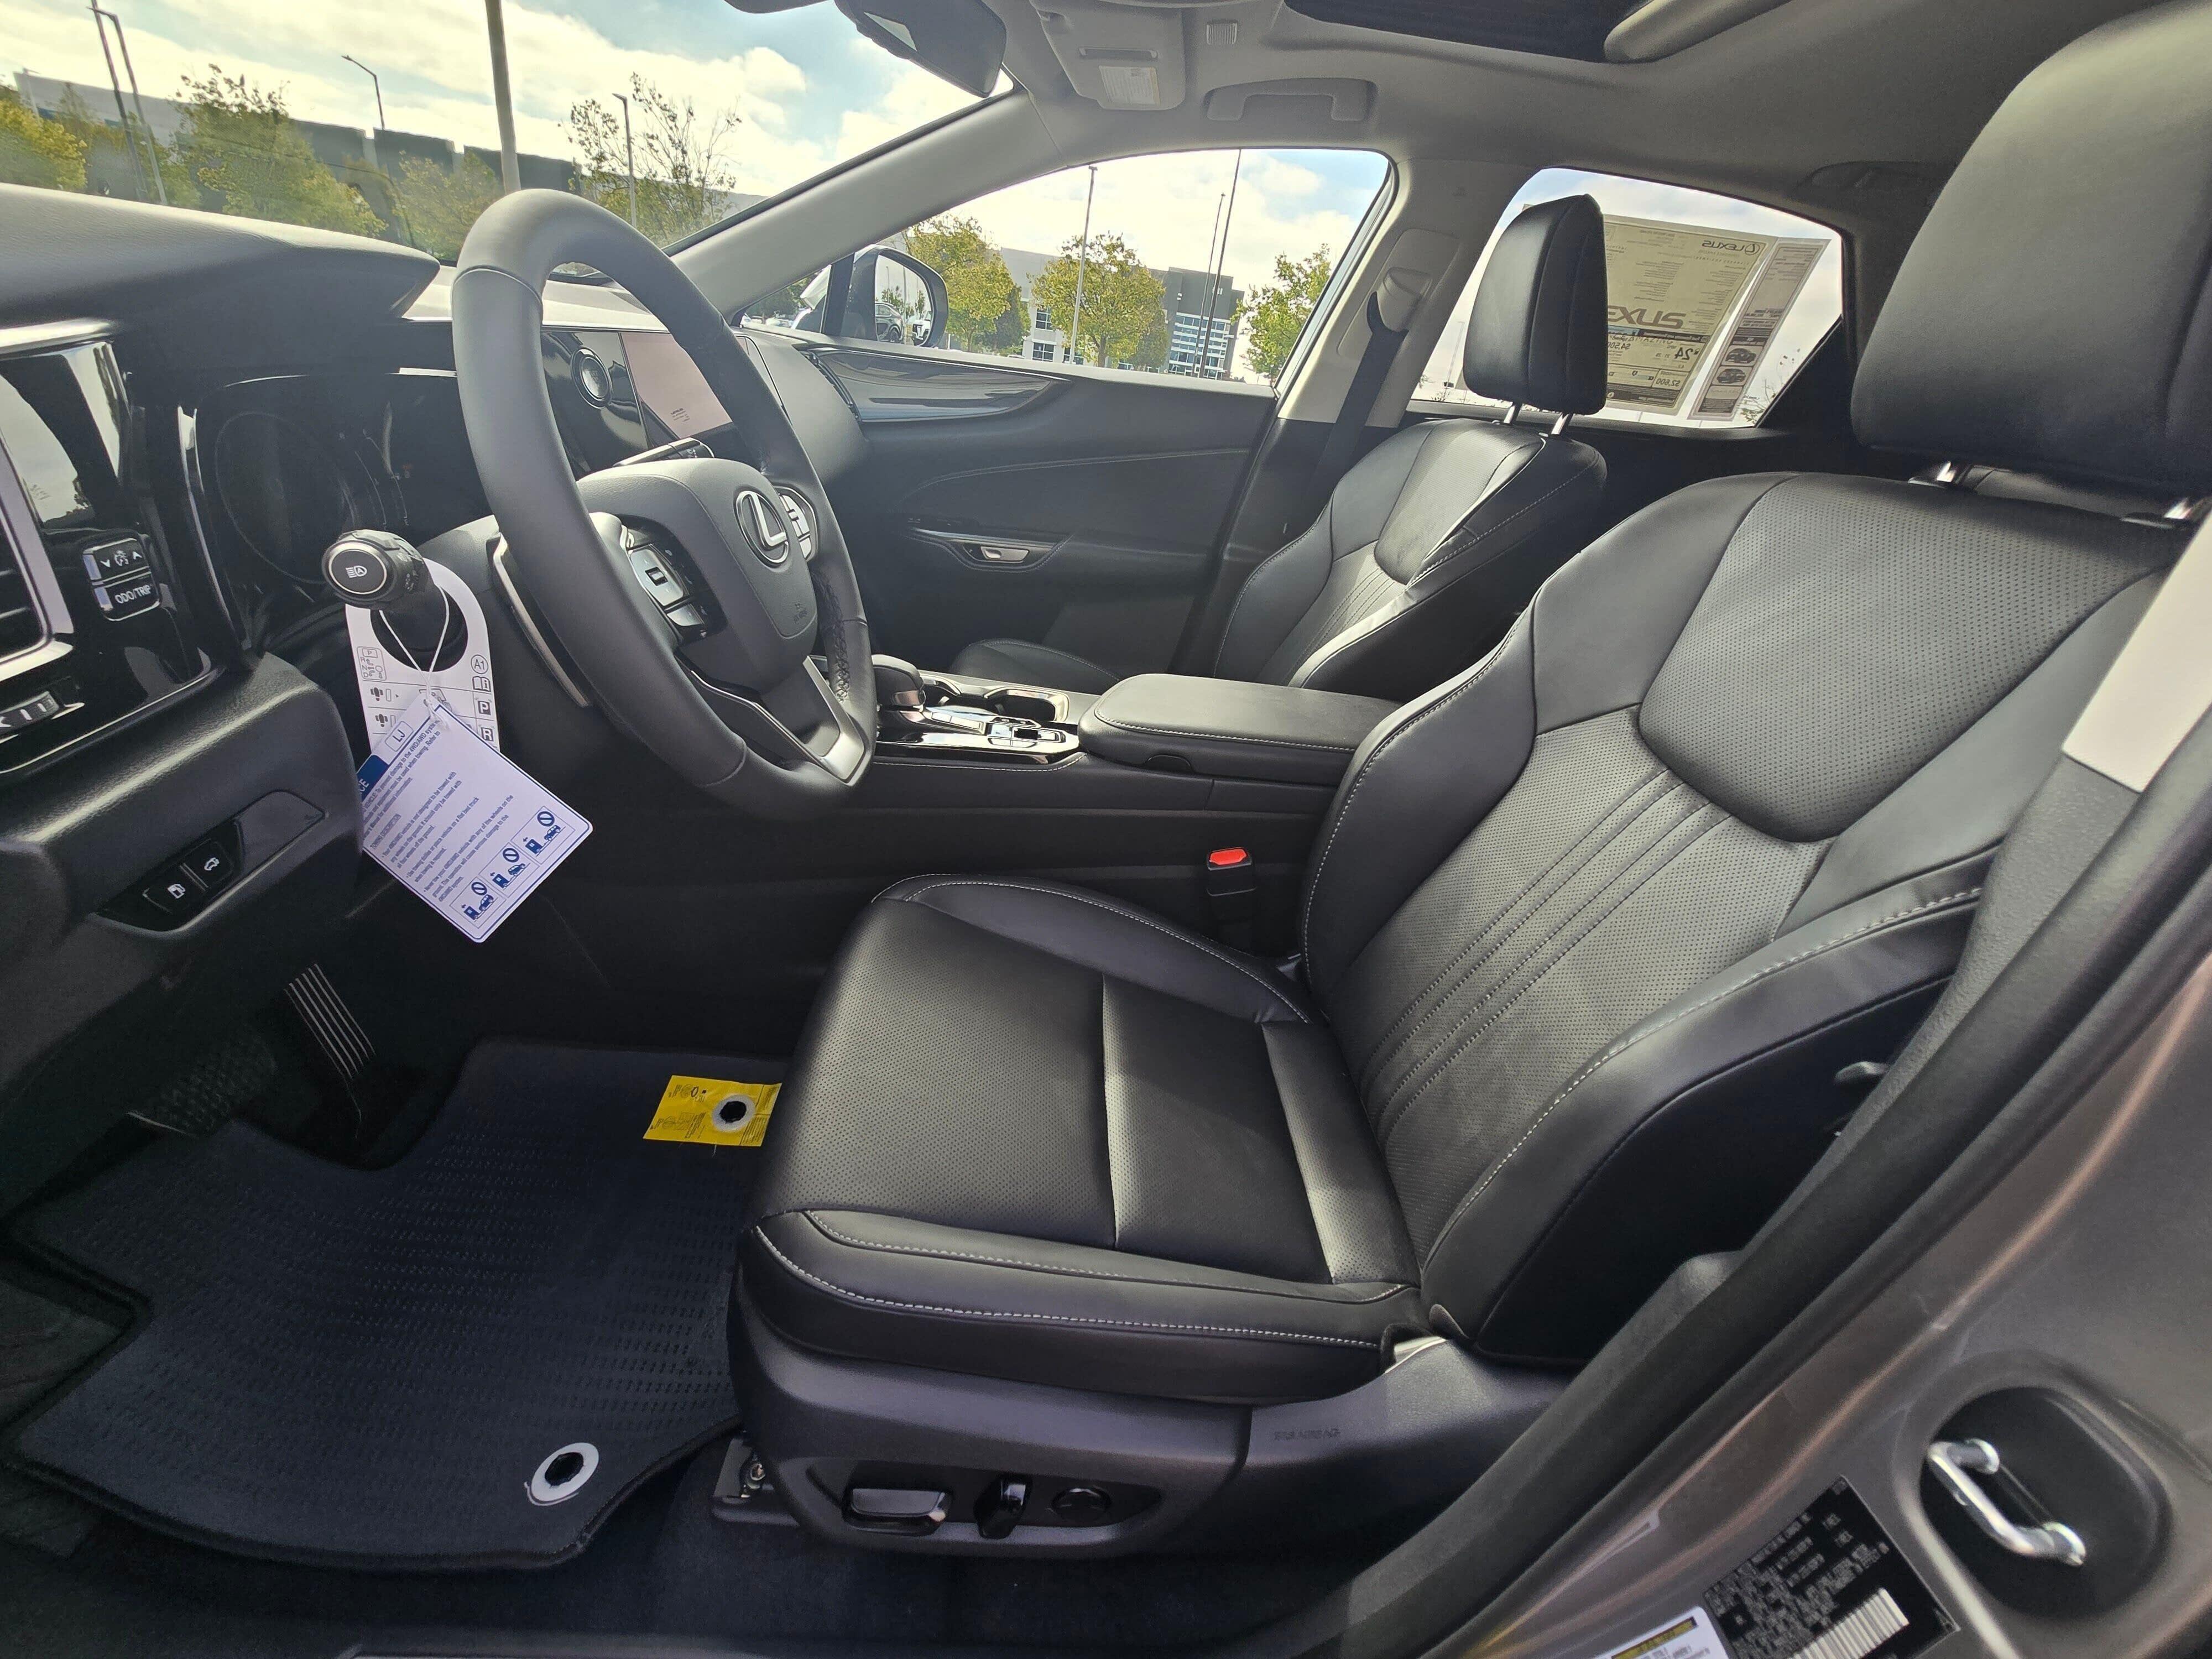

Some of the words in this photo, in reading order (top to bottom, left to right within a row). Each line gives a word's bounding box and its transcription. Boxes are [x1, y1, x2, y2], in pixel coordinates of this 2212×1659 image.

[115, 585, 152, 604] ODO/TRIP
[474, 659, 485, 670] A1
[480, 702, 489, 713] P
[393, 729, 405, 742] LJ
[483, 728, 492, 740] R
[408, 758, 418, 768] when
